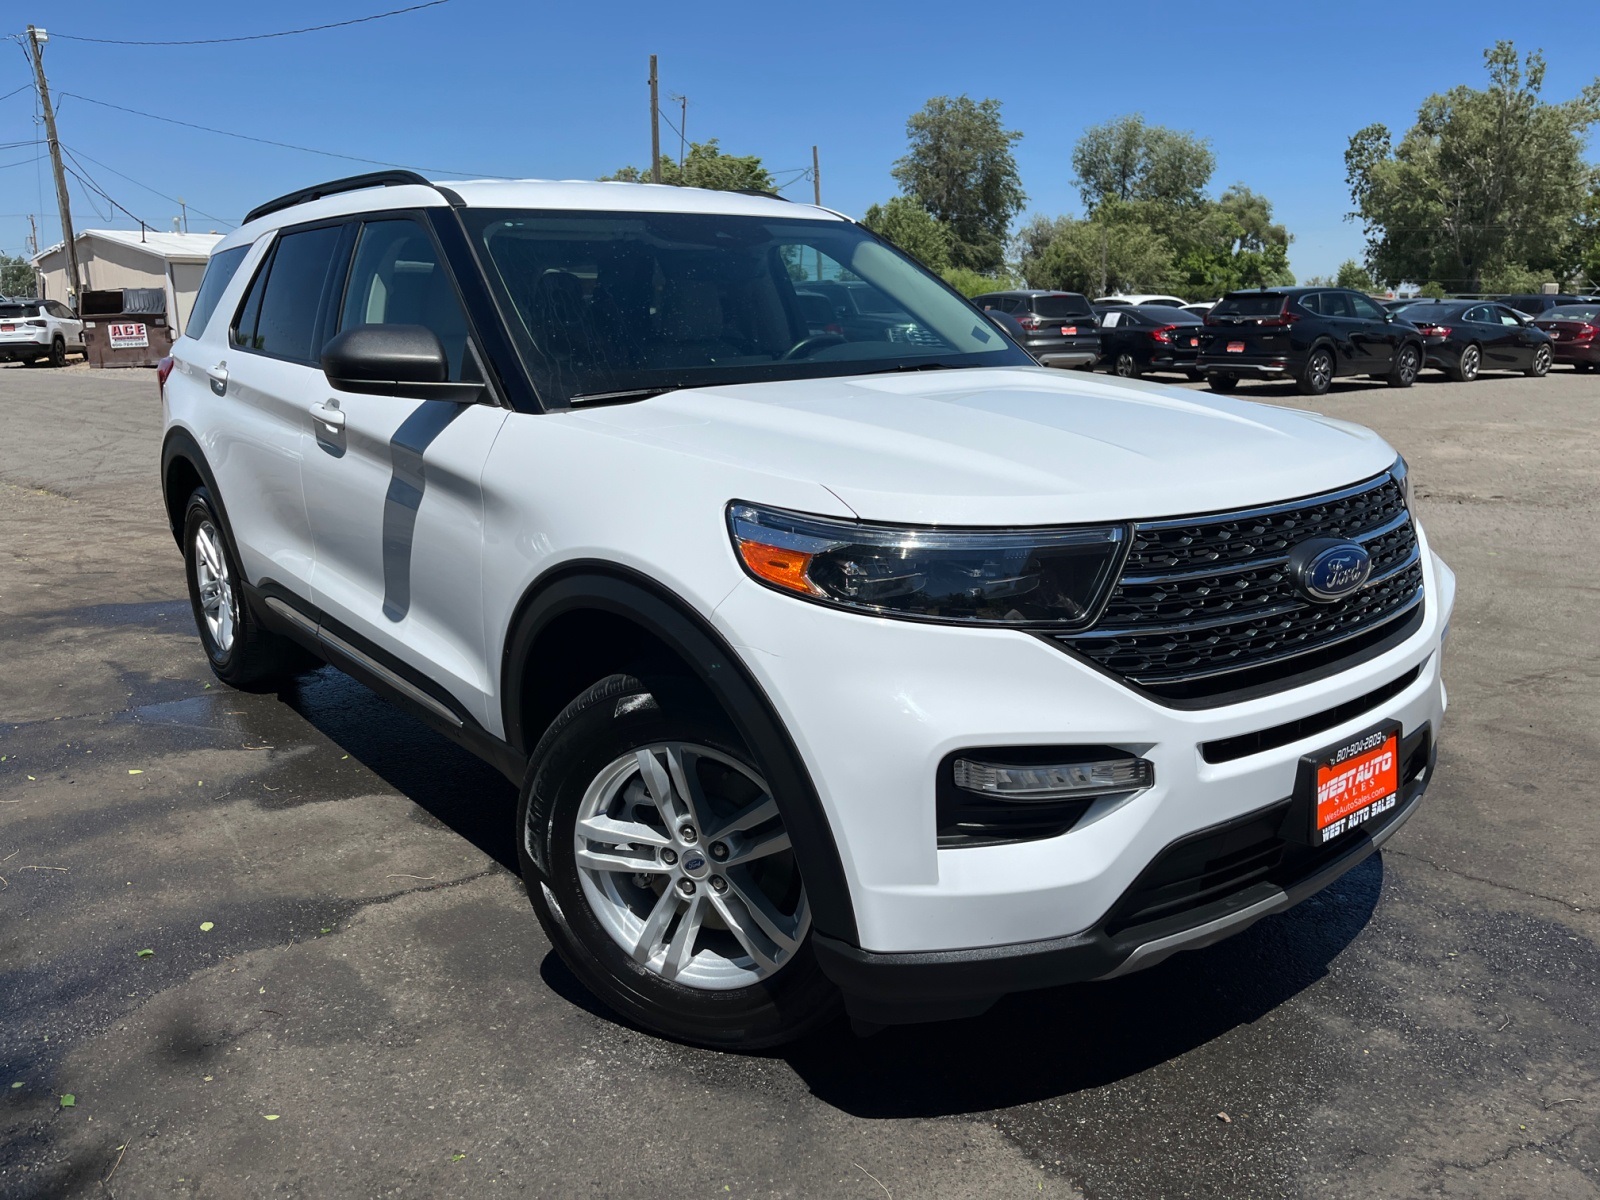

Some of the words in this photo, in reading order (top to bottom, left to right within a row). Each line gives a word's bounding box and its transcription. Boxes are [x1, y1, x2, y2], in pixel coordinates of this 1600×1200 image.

[112, 324, 145, 336] ACE
[1326, 556, 1361, 588] Ford
[1318, 768, 1356, 804] WEST
[1356, 752, 1392, 785] AUTO
[1334, 778, 1375, 805] SALES
[1322, 818, 1346, 842] WEST
[1348, 806, 1370, 829] AUTO
[1371, 793, 1396, 816] SALES
[1324, 786, 1385, 823] WestAutoSales.com
